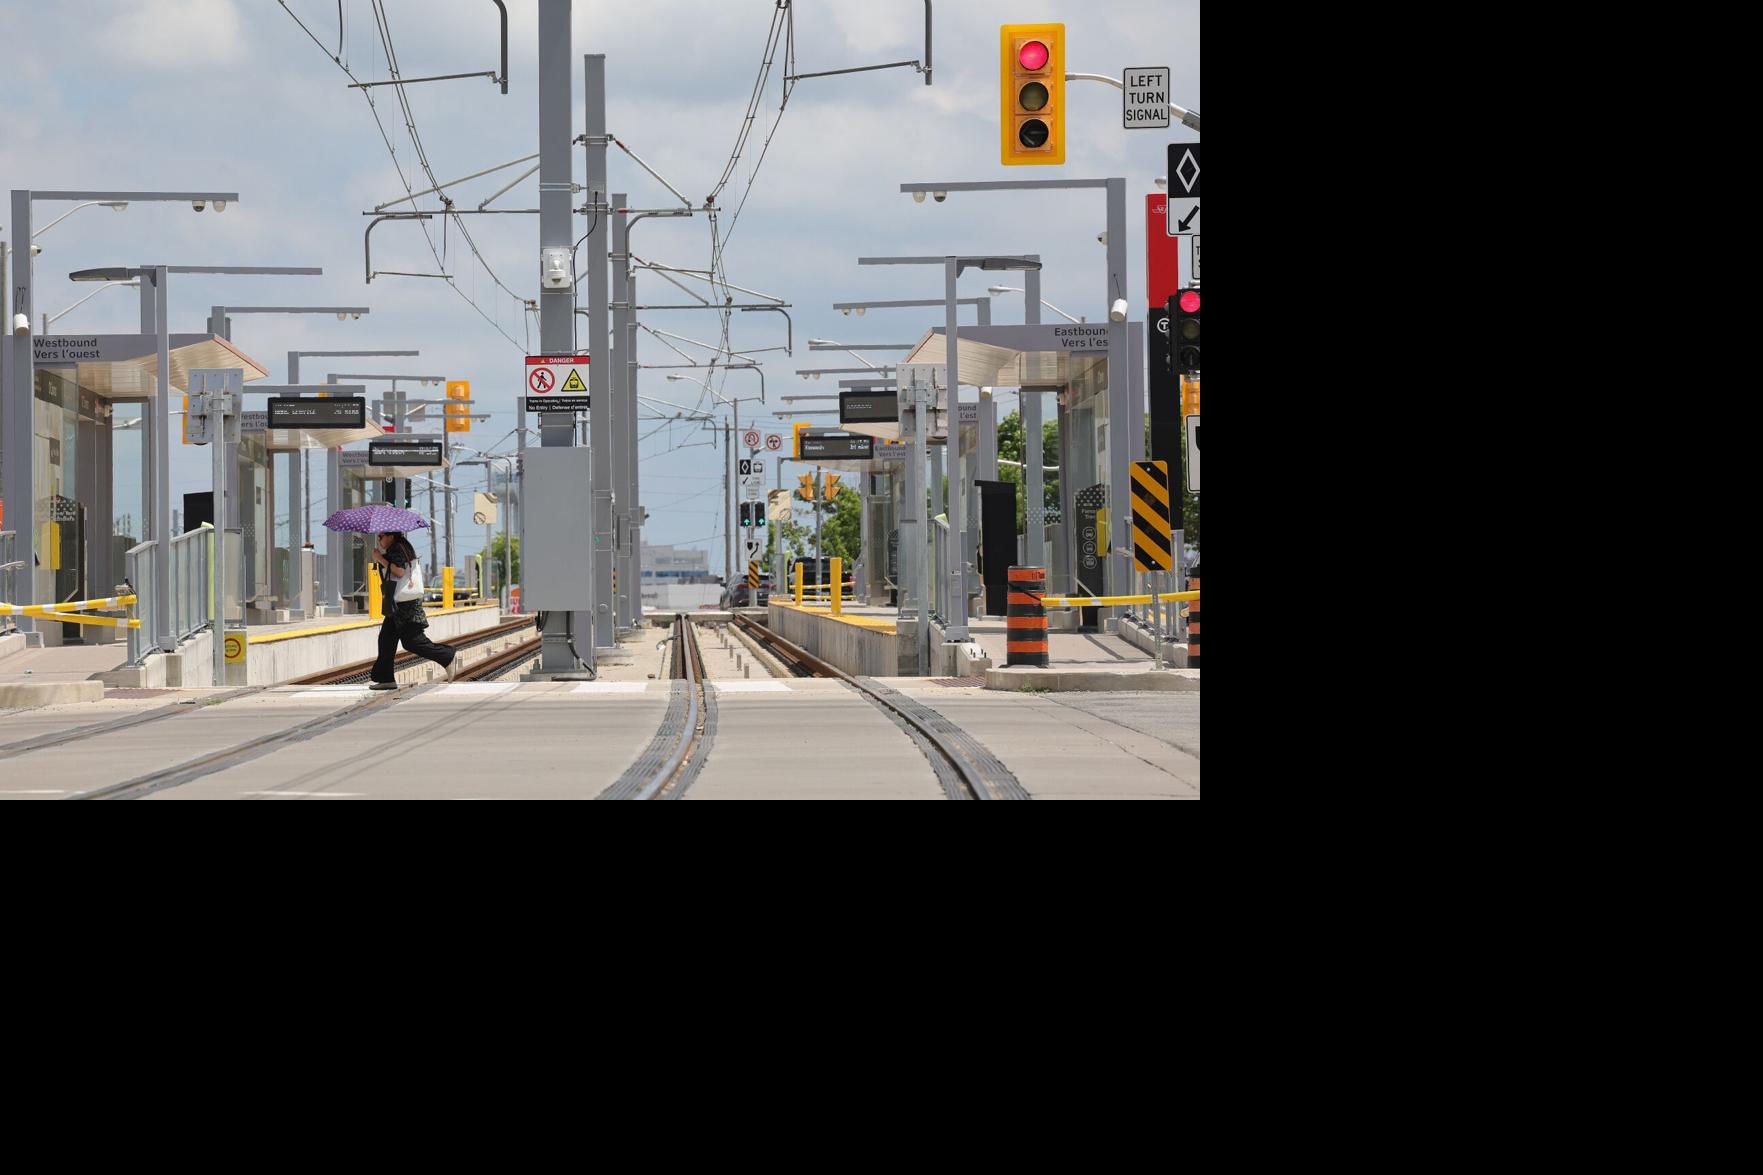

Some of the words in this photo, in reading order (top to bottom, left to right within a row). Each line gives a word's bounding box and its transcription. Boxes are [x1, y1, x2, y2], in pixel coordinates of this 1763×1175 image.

[1131, 75, 1162, 87] LEFT
[1129, 92, 1164, 104] TURN
[1126, 109, 1167, 121] SIGNAL
[1054, 327, 1108, 336] Eastboun
[34, 338, 97, 347] Westbound
[1062, 338, 1086, 347] Vers
[1089, 337, 1108, 347] l'es
[34, 350, 59, 359] Vers
[62, 349, 101, 358] l'ouest
